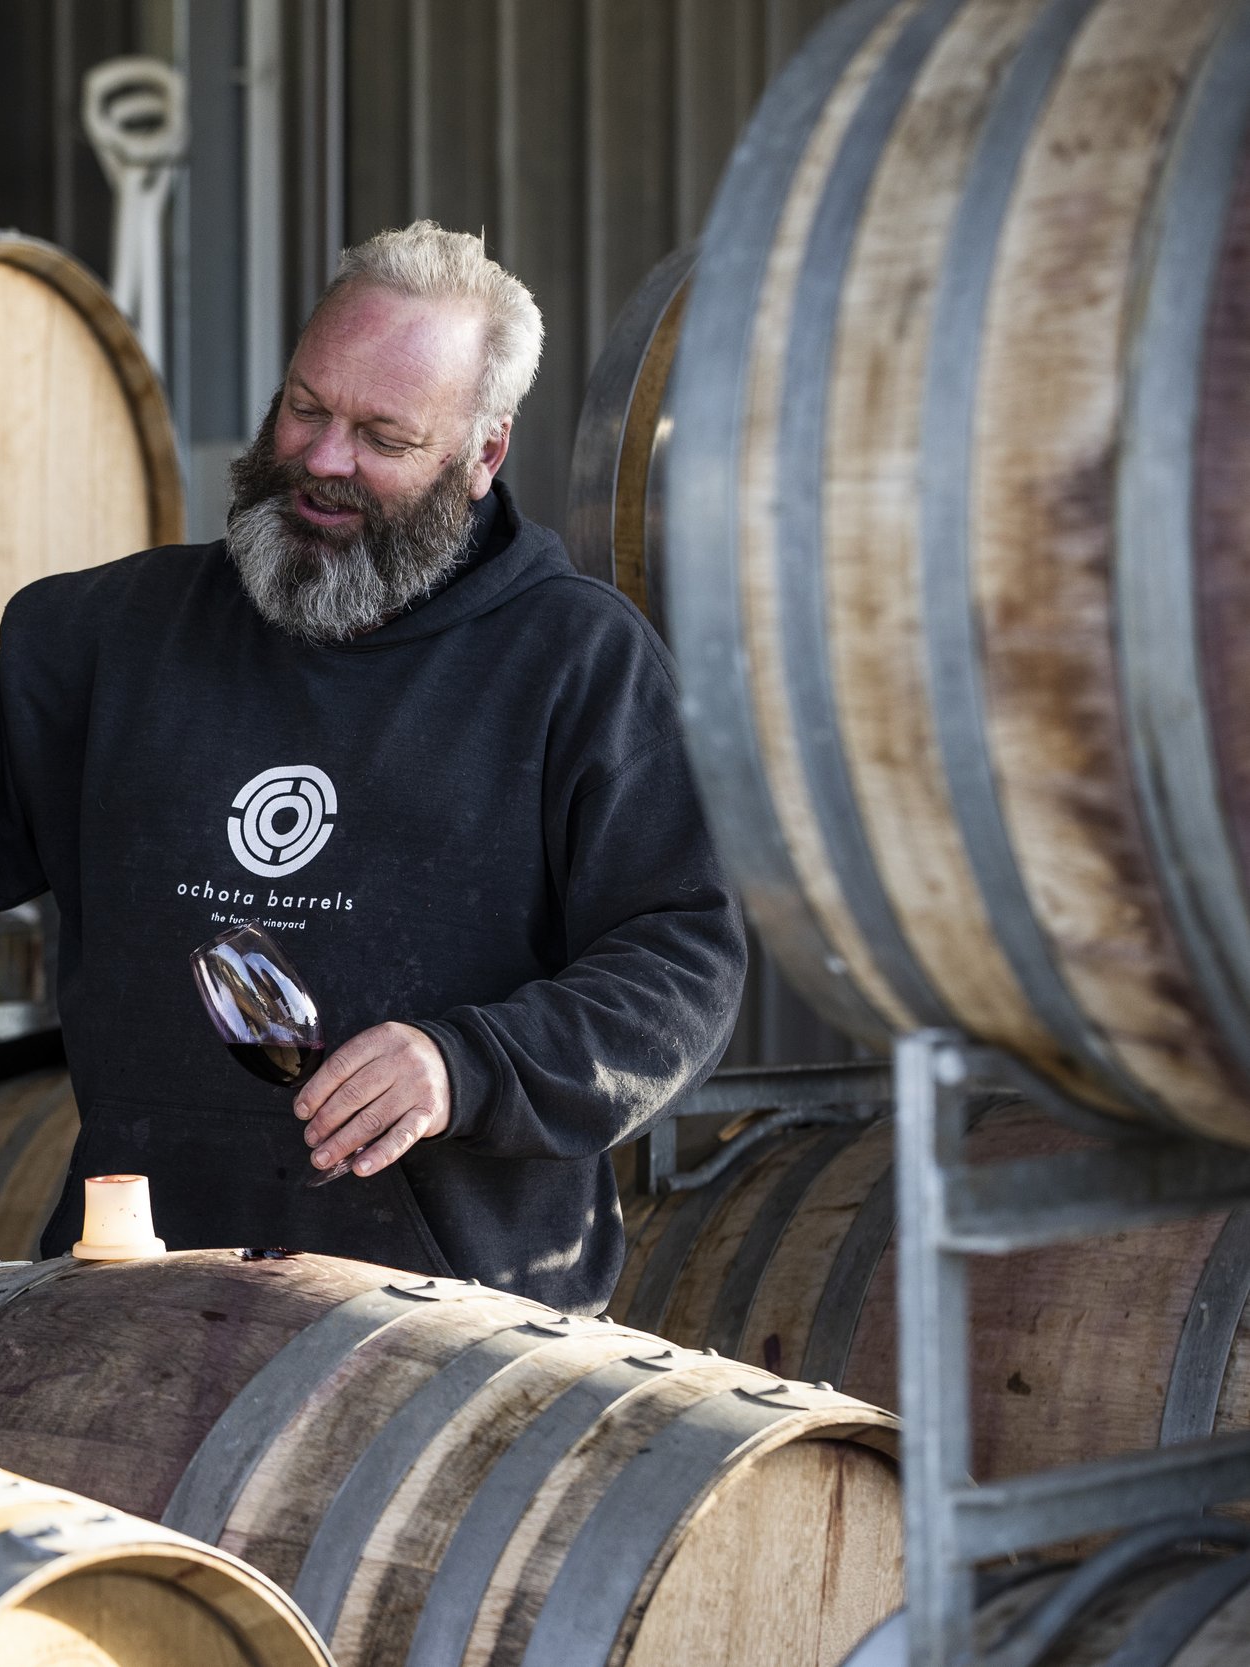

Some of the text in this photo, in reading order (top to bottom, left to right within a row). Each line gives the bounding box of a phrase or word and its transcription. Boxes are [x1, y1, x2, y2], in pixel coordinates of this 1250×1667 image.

[177, 880, 354, 911] ochota barrels
[210, 911, 226, 923] the
[262, 918, 306, 931] vineyard
